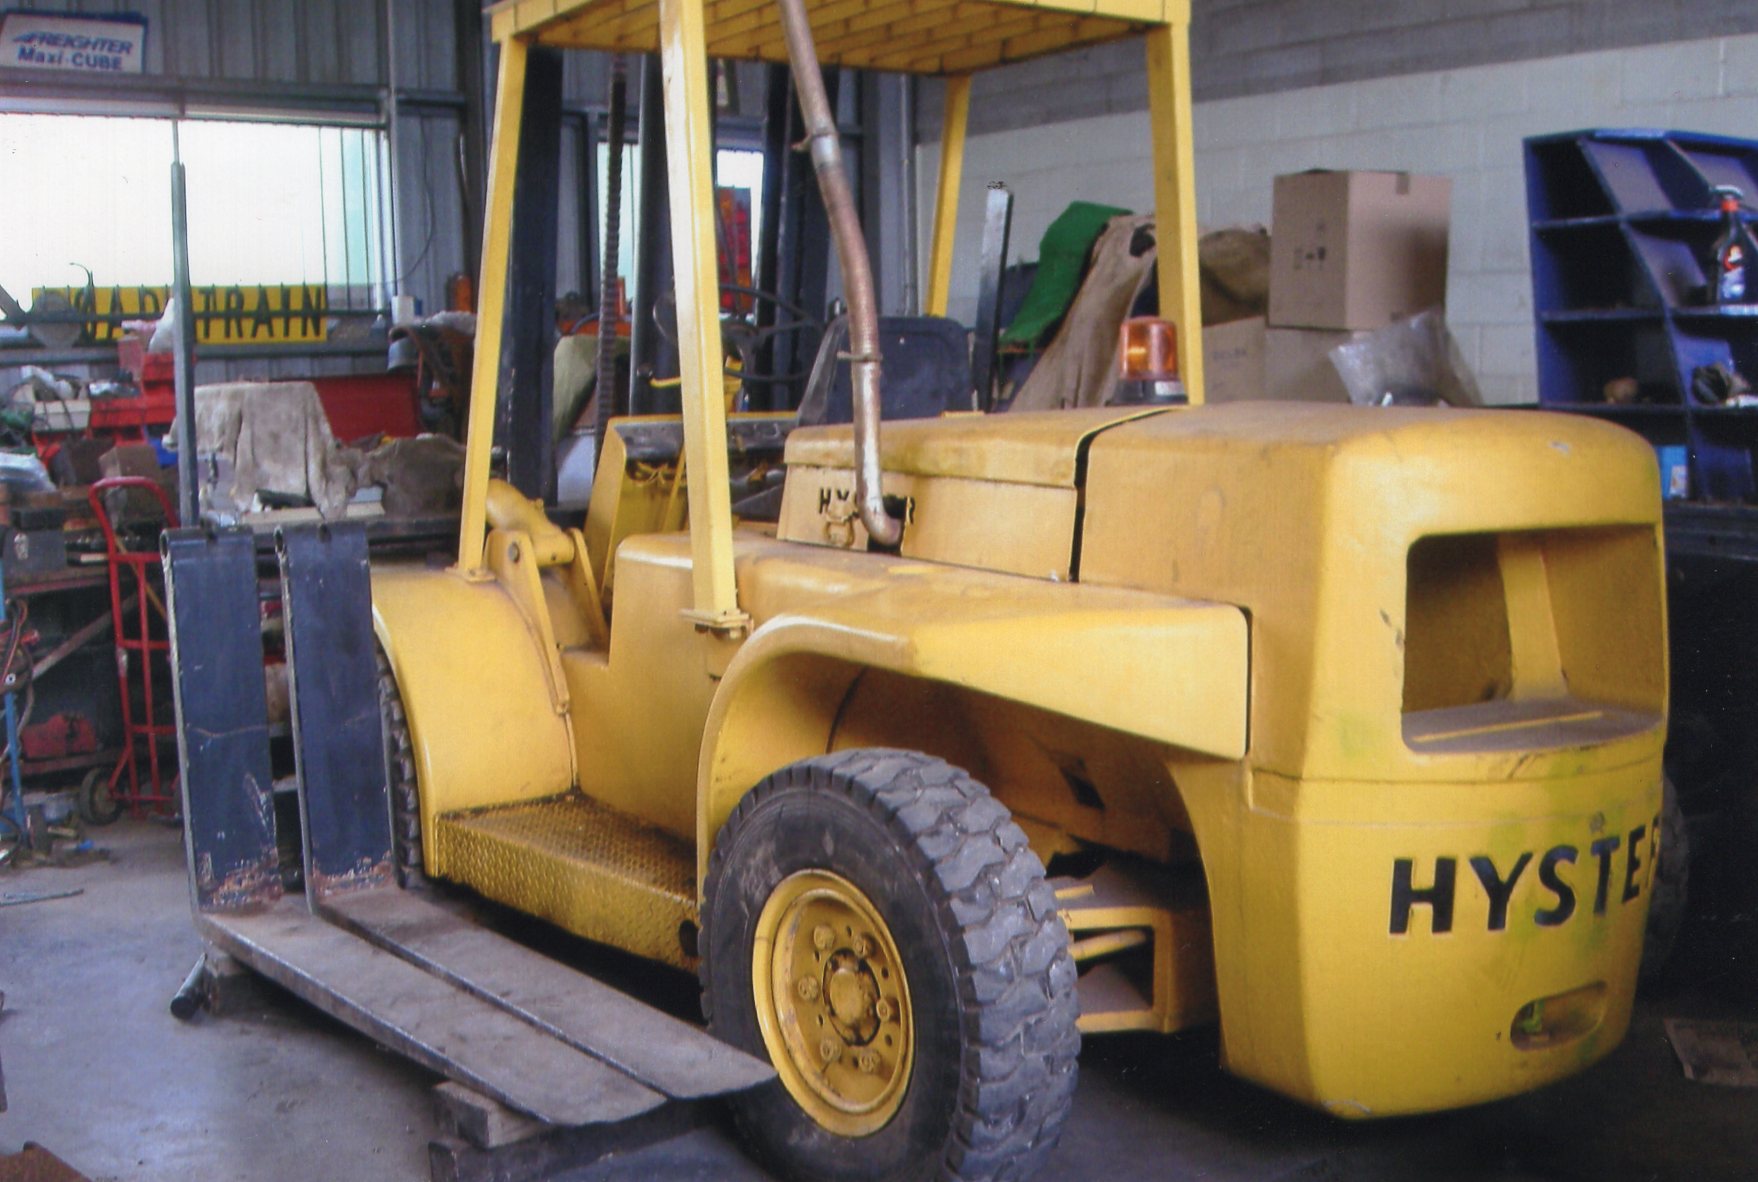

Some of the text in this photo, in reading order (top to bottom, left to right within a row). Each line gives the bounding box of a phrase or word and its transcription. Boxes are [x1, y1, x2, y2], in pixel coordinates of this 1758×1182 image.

[14, 31, 133, 54] FREIGHTER
[44, 285, 322, 342] OAD TRAIN
